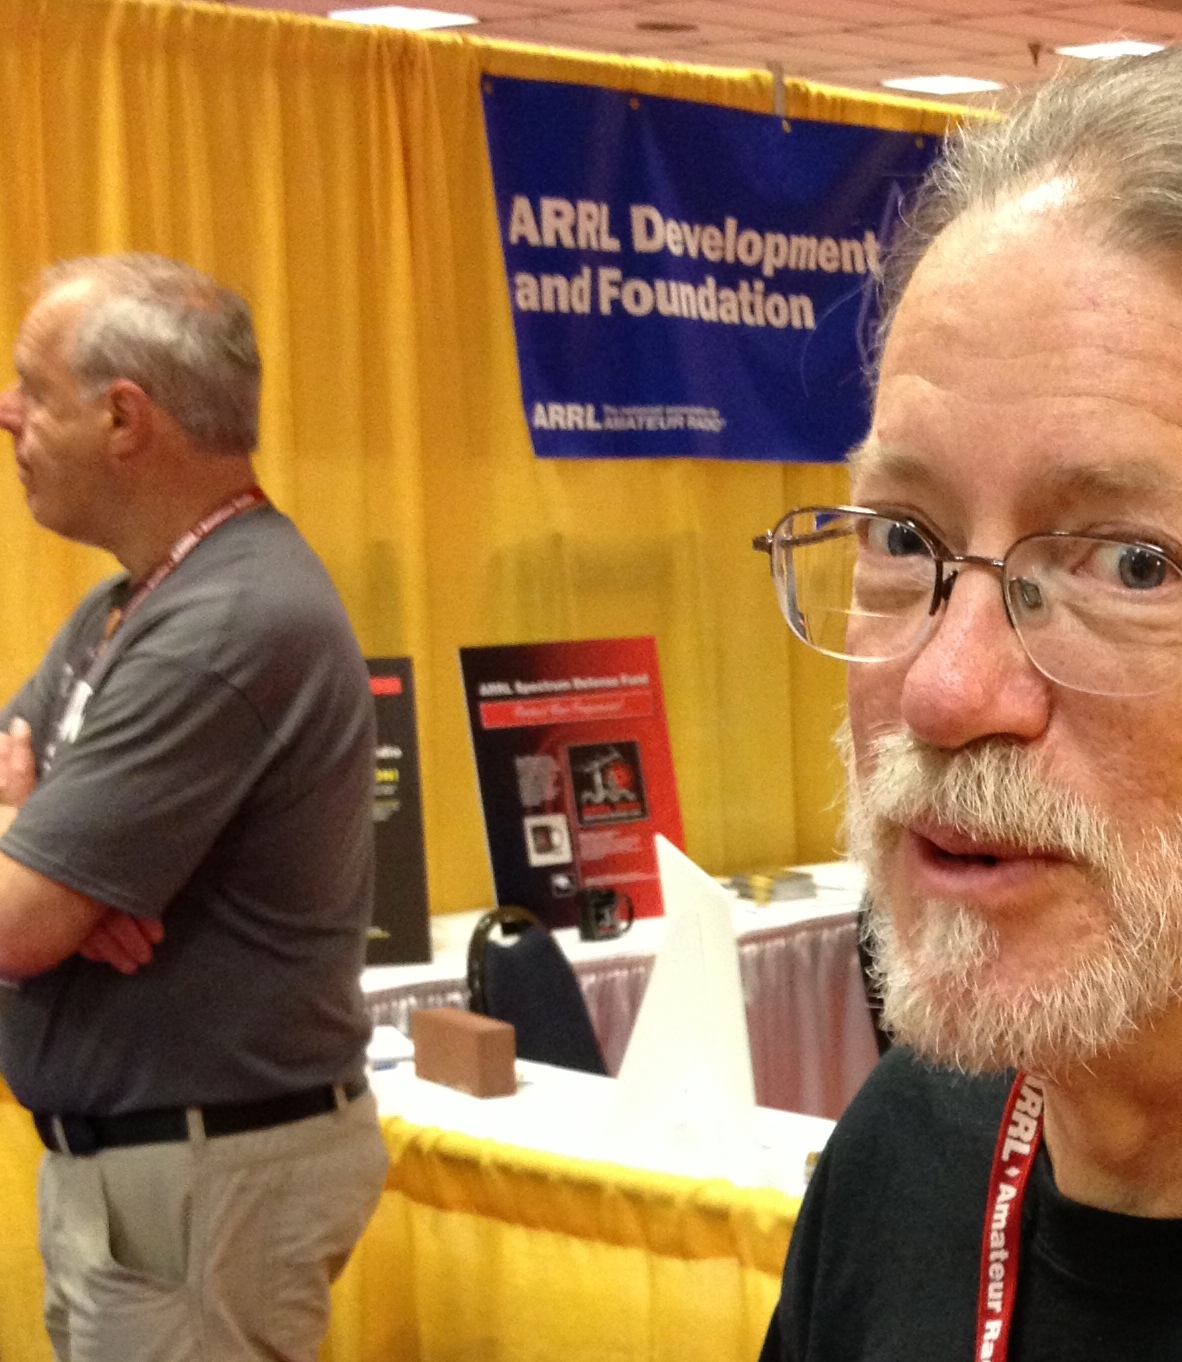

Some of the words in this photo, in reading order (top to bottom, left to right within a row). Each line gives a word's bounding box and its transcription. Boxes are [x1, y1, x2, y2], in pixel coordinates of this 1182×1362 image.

[509, 194, 620, 253] ARRL
[630, 203, 881, 277] Development
[515, 266, 592, 315] and
[599, 266, 816, 331] Foundation
[533, 403, 602, 432] ARRL
[987, 1182, 1018, 1315] Amateur
